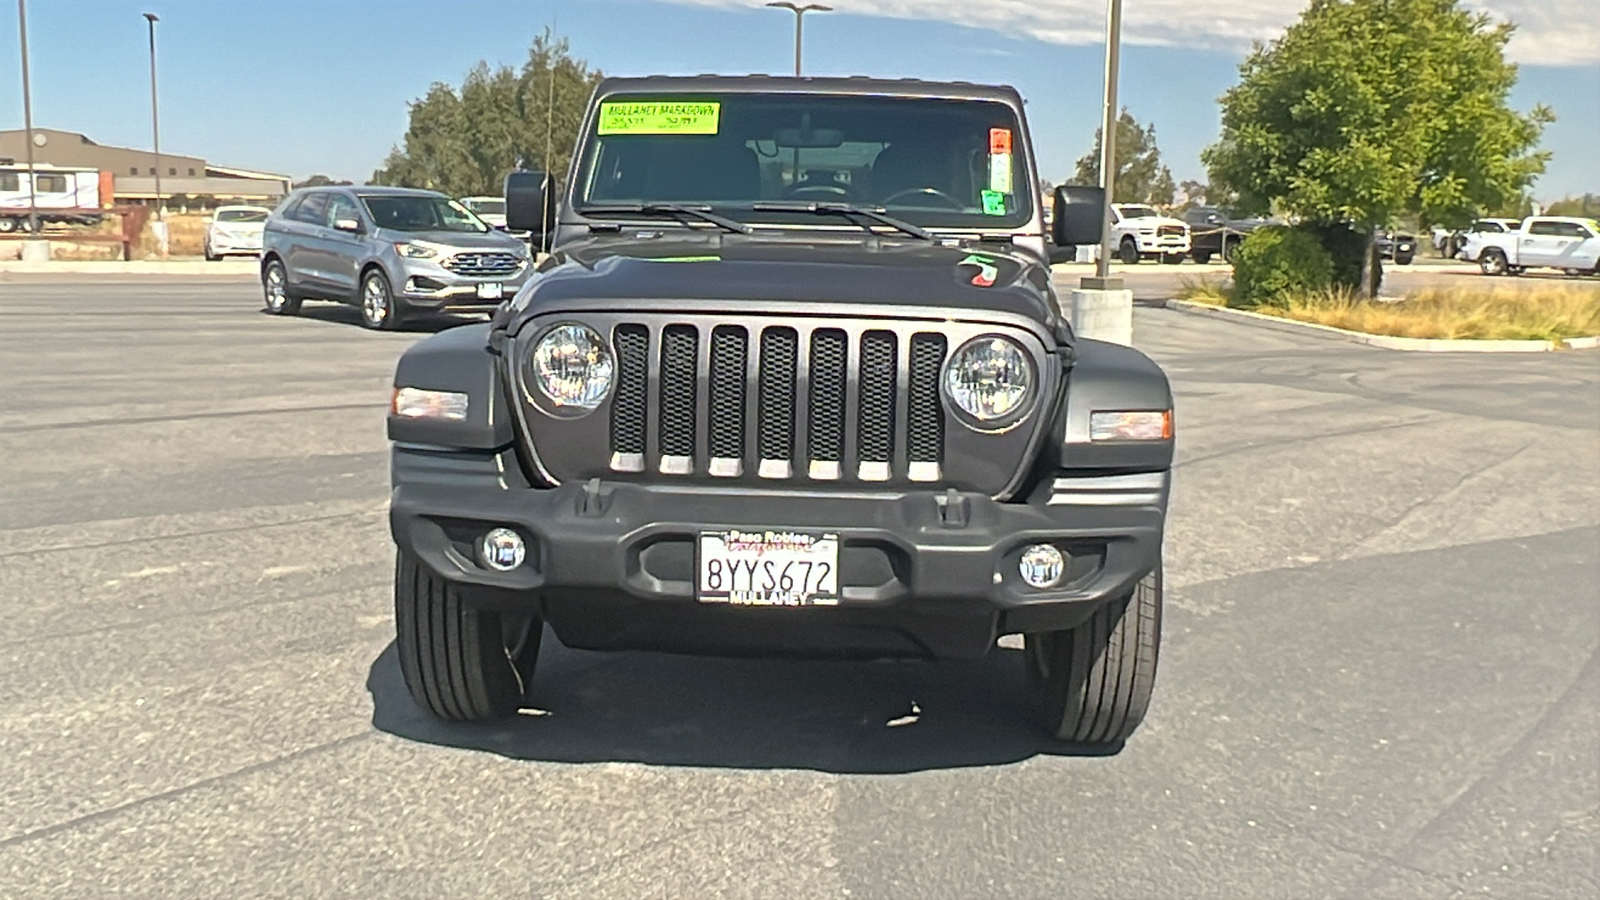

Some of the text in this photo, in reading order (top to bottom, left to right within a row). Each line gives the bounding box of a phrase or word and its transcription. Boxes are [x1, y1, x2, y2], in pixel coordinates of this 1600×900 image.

[659, 105, 715, 117] MARKDOWN
[730, 530, 810, 544] Paso Robles
[708, 558, 831, 595] 8YYS672
[729, 590, 809, 606] MULLAHEY
